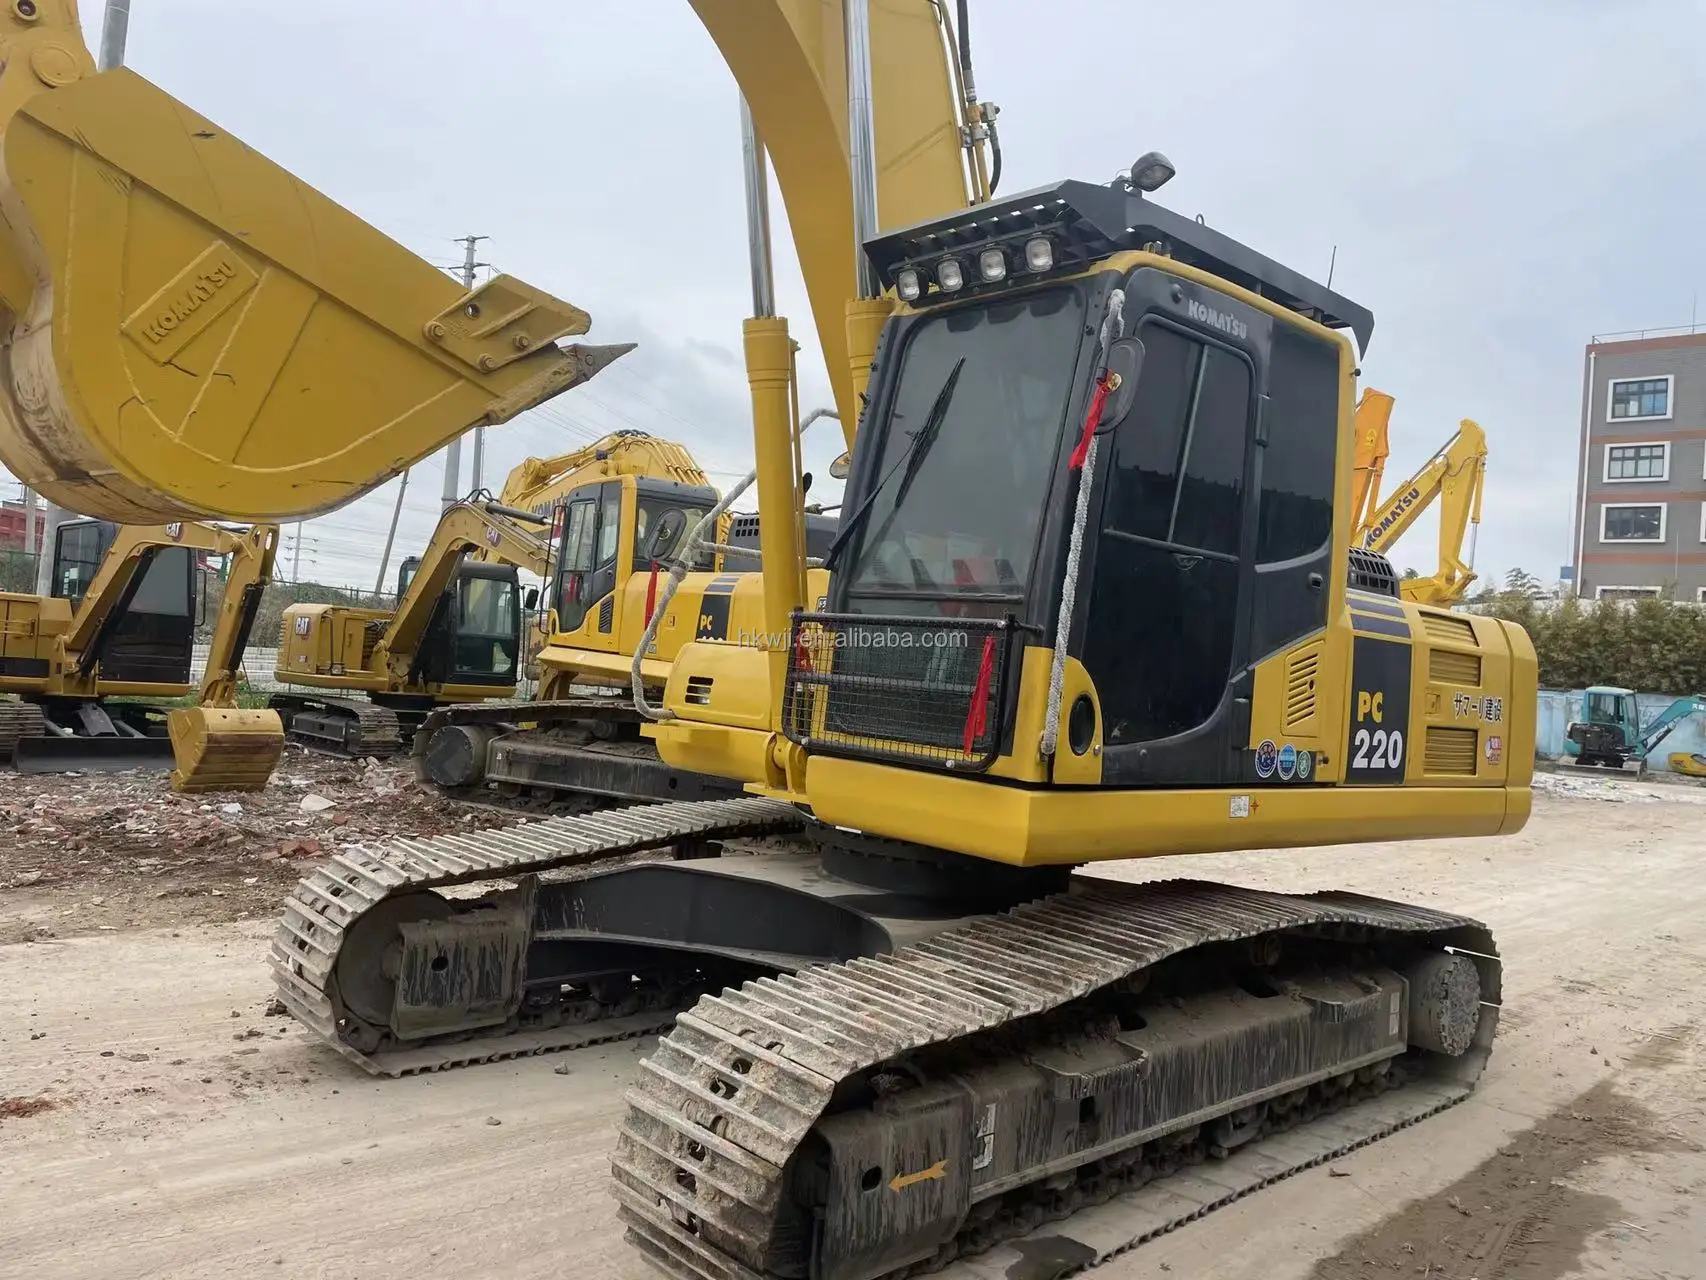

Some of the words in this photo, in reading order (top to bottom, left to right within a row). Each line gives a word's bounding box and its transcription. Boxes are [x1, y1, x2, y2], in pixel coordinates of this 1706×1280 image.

[142, 261, 238, 346] KOMATSU
[1188, 298, 1248, 341] KOMATSU
[166, 522, 182, 538] CAT
[1366, 487, 1420, 548] KOMATSU
[295, 617, 310, 635] CAT
[700, 614, 713, 631] PC
[1357, 691, 1383, 723] PC
[1352, 729, 1403, 769] 220
